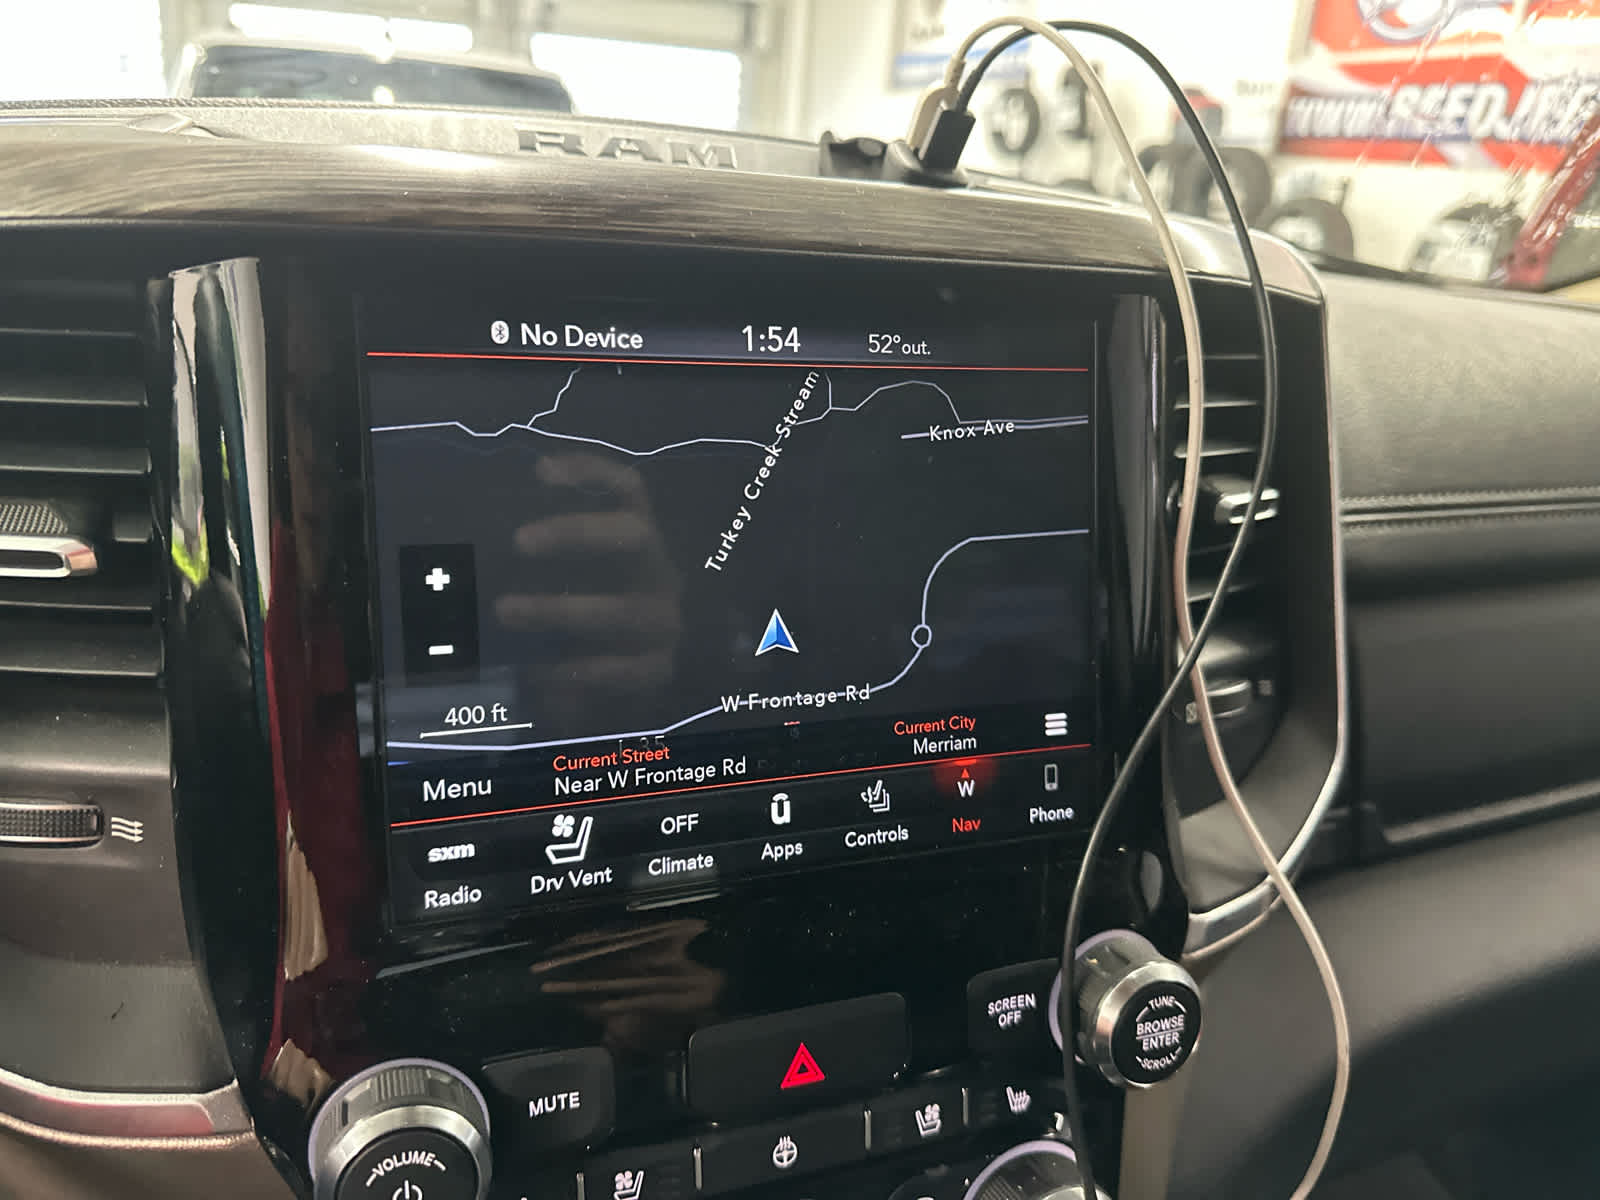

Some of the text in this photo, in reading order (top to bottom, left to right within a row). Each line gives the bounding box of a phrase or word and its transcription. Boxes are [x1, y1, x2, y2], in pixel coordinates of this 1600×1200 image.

[518, 129, 738, 170] RAM
[521, 323, 643, 349] No Device
[742, 326, 801, 354] 1:54
[929, 419, 1015, 442] Knox Ave
[704, 370, 820, 572] Turkey Creek Stream
[721, 684, 871, 712] W Frontage Rd
[445, 702, 508, 725] 400 ft
[895, 716, 977, 737] Current City
[913, 736, 977, 754] Merriam
[554, 745, 670, 771] Current Street
[554, 756, 746, 796] Near W Frontage Rd
[422, 777, 492, 800] Menu
[957, 781, 975, 797] W
[661, 813, 699, 835] OFF
[1029, 803, 1074, 824] Phone
[845, 824, 909, 845] Controls
[952, 817, 981, 833] Nav
[428, 841, 475, 860] sxm
[762, 841, 802, 862] Apps
[649, 853, 713, 875] Climate
[531, 867, 612, 894] Drv Vent
[424, 885, 482, 907] Radio
[987, 994, 1035, 1013] SCREEN
[1149, 996, 1176, 1010] TUNE
[998, 1010, 1022, 1026] OFF
[1136, 1015, 1184, 1034] BROWSE
[1142, 1033, 1180, 1050] ENTER
[1141, 1053, 1176, 1070] SCROLL
[528, 1091, 580, 1116] MUTE
[372, 1151, 436, 1178] VOLUME
